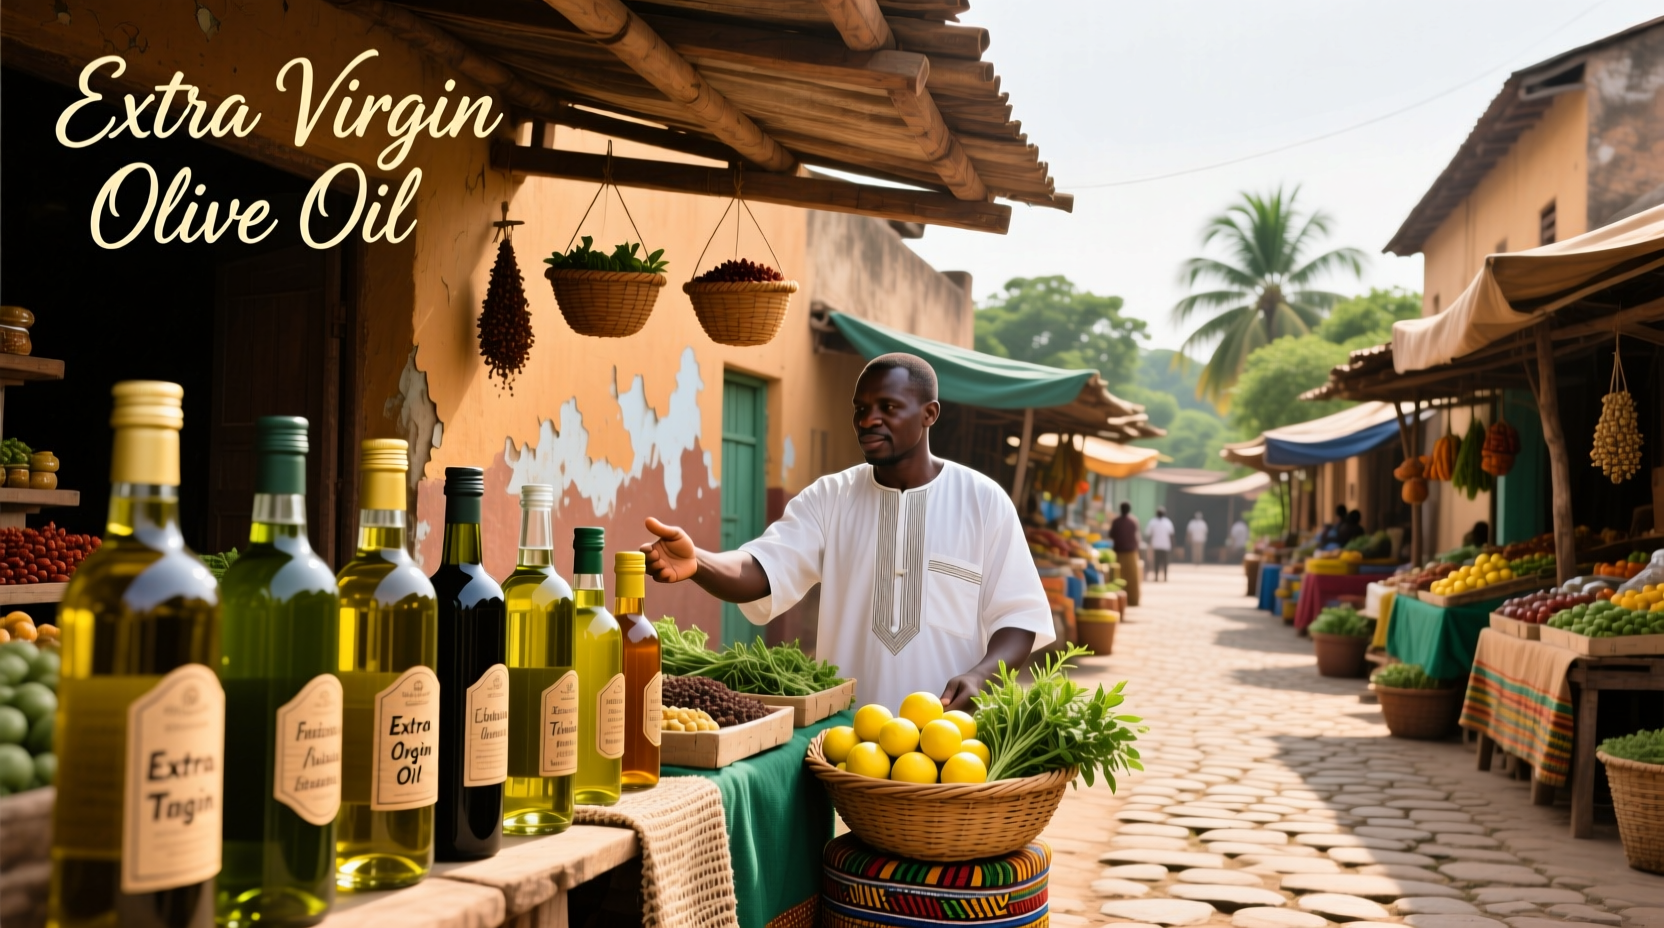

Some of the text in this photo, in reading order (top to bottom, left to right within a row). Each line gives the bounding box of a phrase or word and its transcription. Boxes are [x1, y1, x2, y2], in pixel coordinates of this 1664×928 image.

[389, 715, 431, 736] Extra
[391, 741, 431, 764] Orgin
[146, 751, 214, 782] Extra
